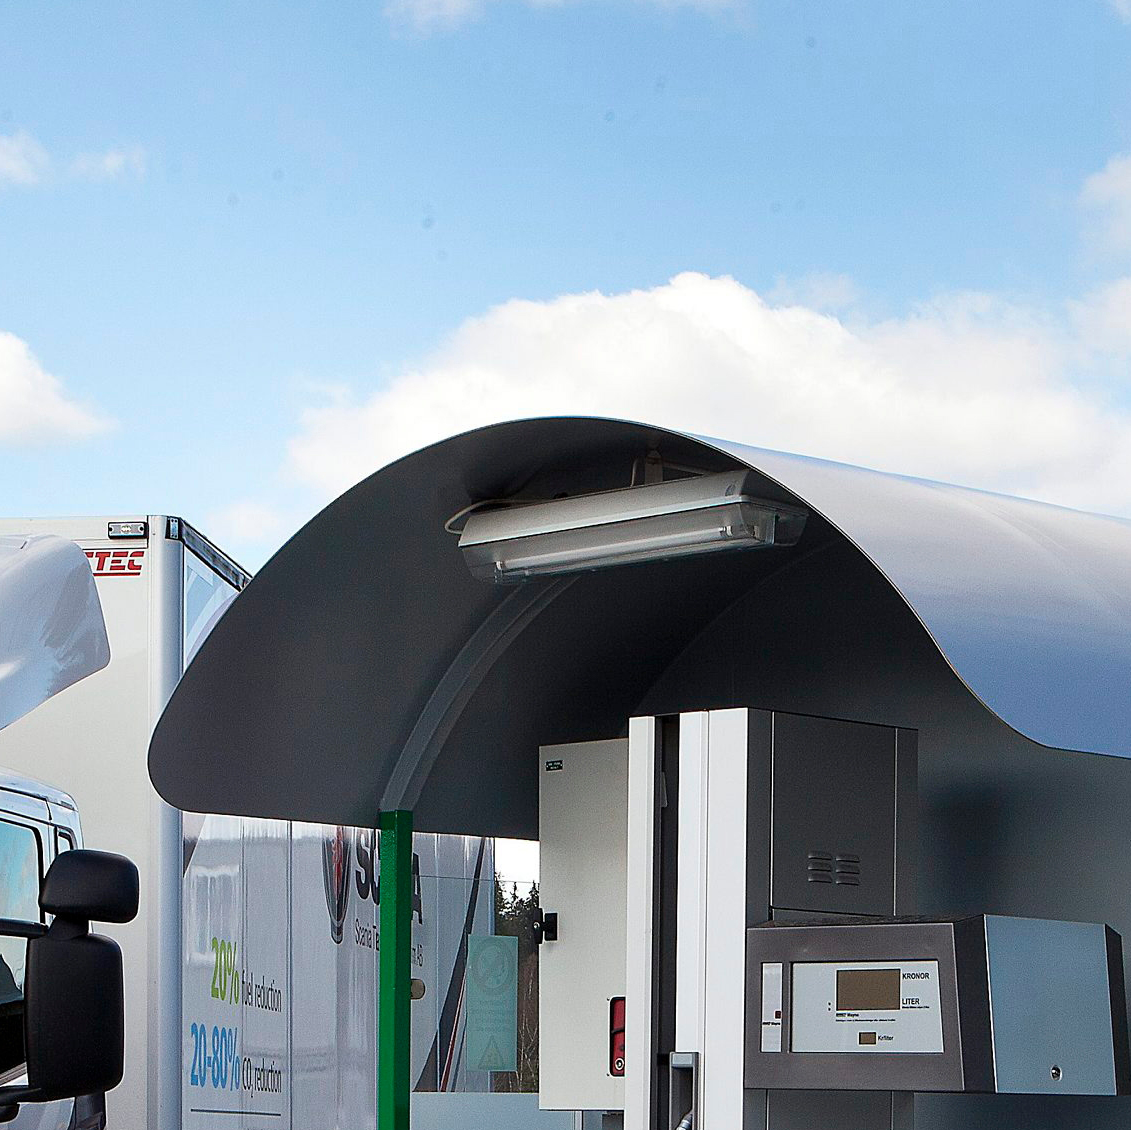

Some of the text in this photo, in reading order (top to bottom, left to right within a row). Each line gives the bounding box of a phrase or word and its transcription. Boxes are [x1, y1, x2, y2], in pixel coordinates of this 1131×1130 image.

[85, 551, 145, 571] TEC
[210, 936, 282, 1013] 20% fuel reduction
[902, 972, 930, 980] KRONOR
[902, 997, 920, 1005] LITER
[190, 1022, 240, 1092] 20-80%
[255, 1058, 282, 1093] reduction
